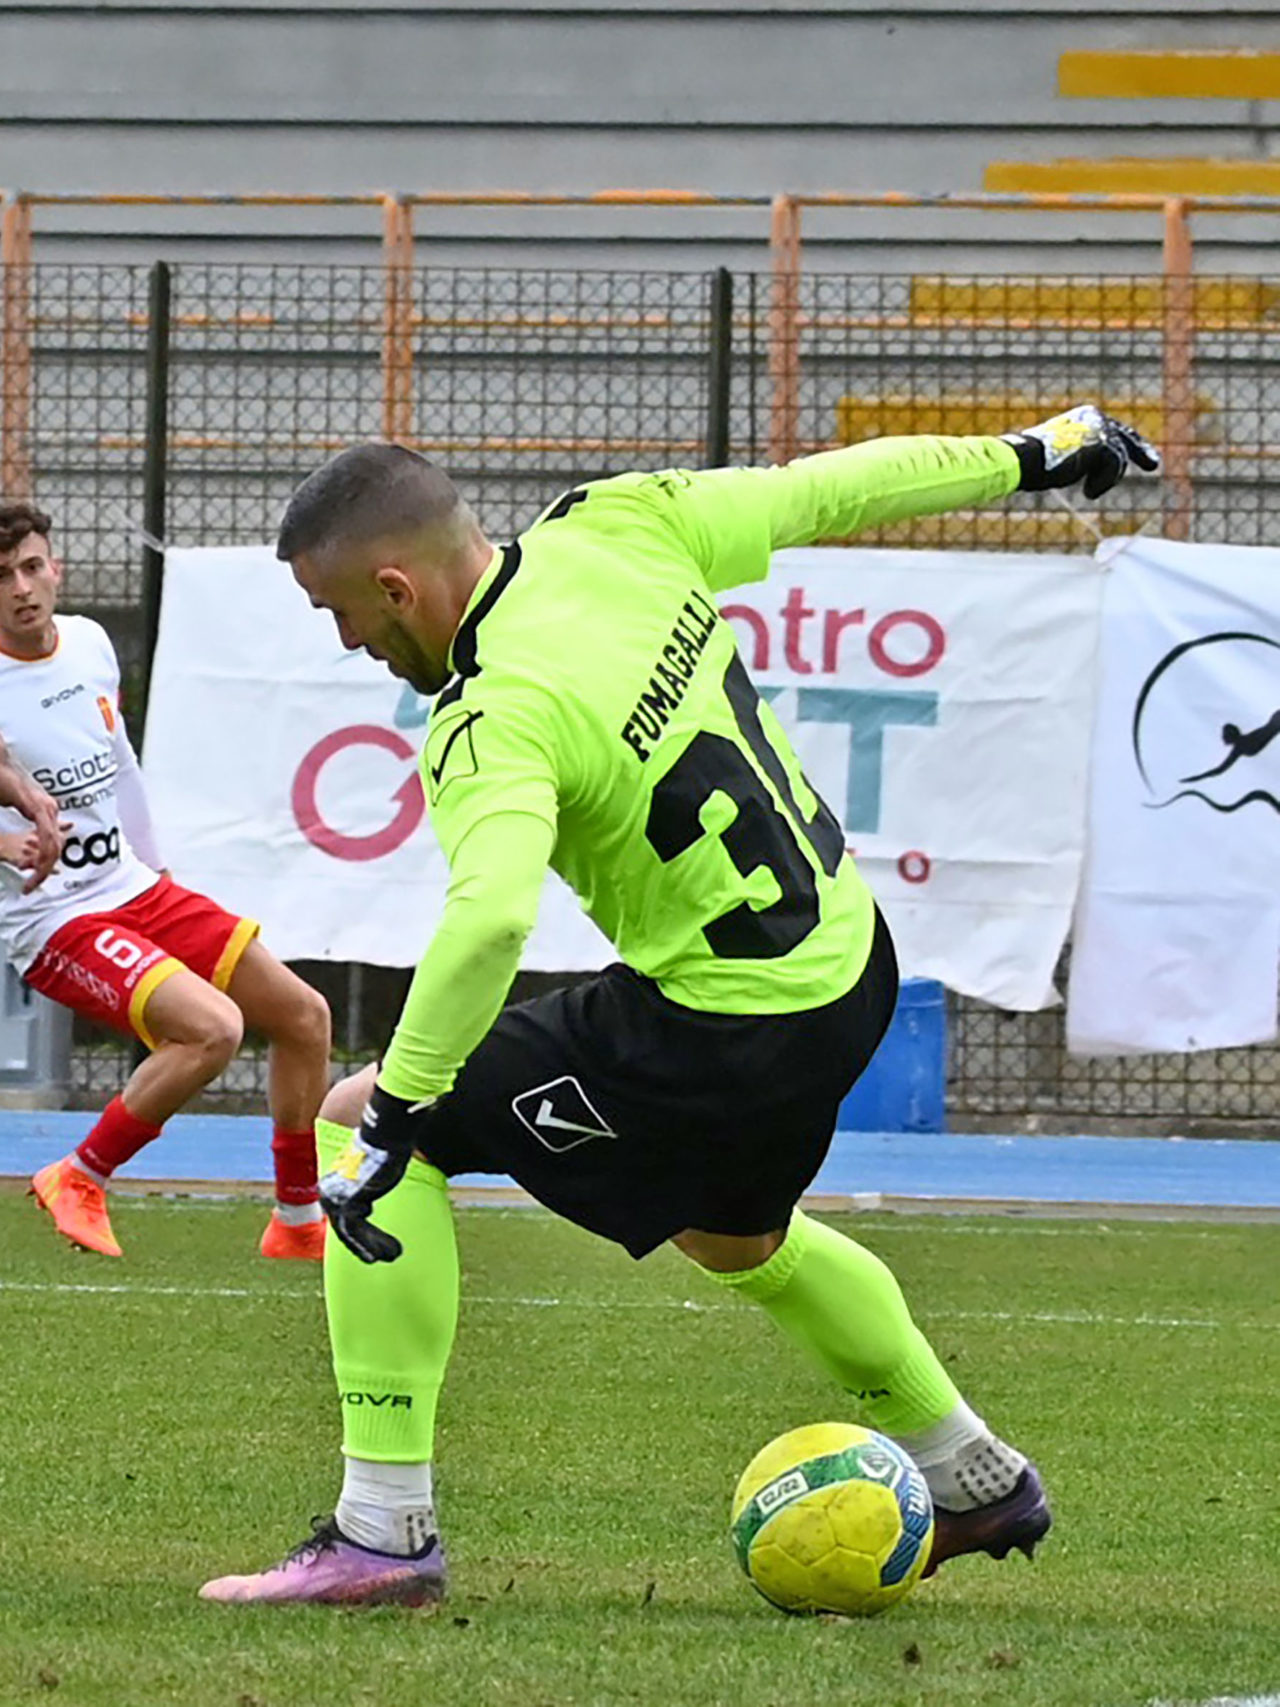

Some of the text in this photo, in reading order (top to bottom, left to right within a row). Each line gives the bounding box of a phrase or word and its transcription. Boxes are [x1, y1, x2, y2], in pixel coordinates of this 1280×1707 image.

[621, 589, 719, 763] FUMAGALLI
[758, 685, 939, 834] T
[94, 928, 143, 969] 6
[341, 1392, 413, 1410] OVA
